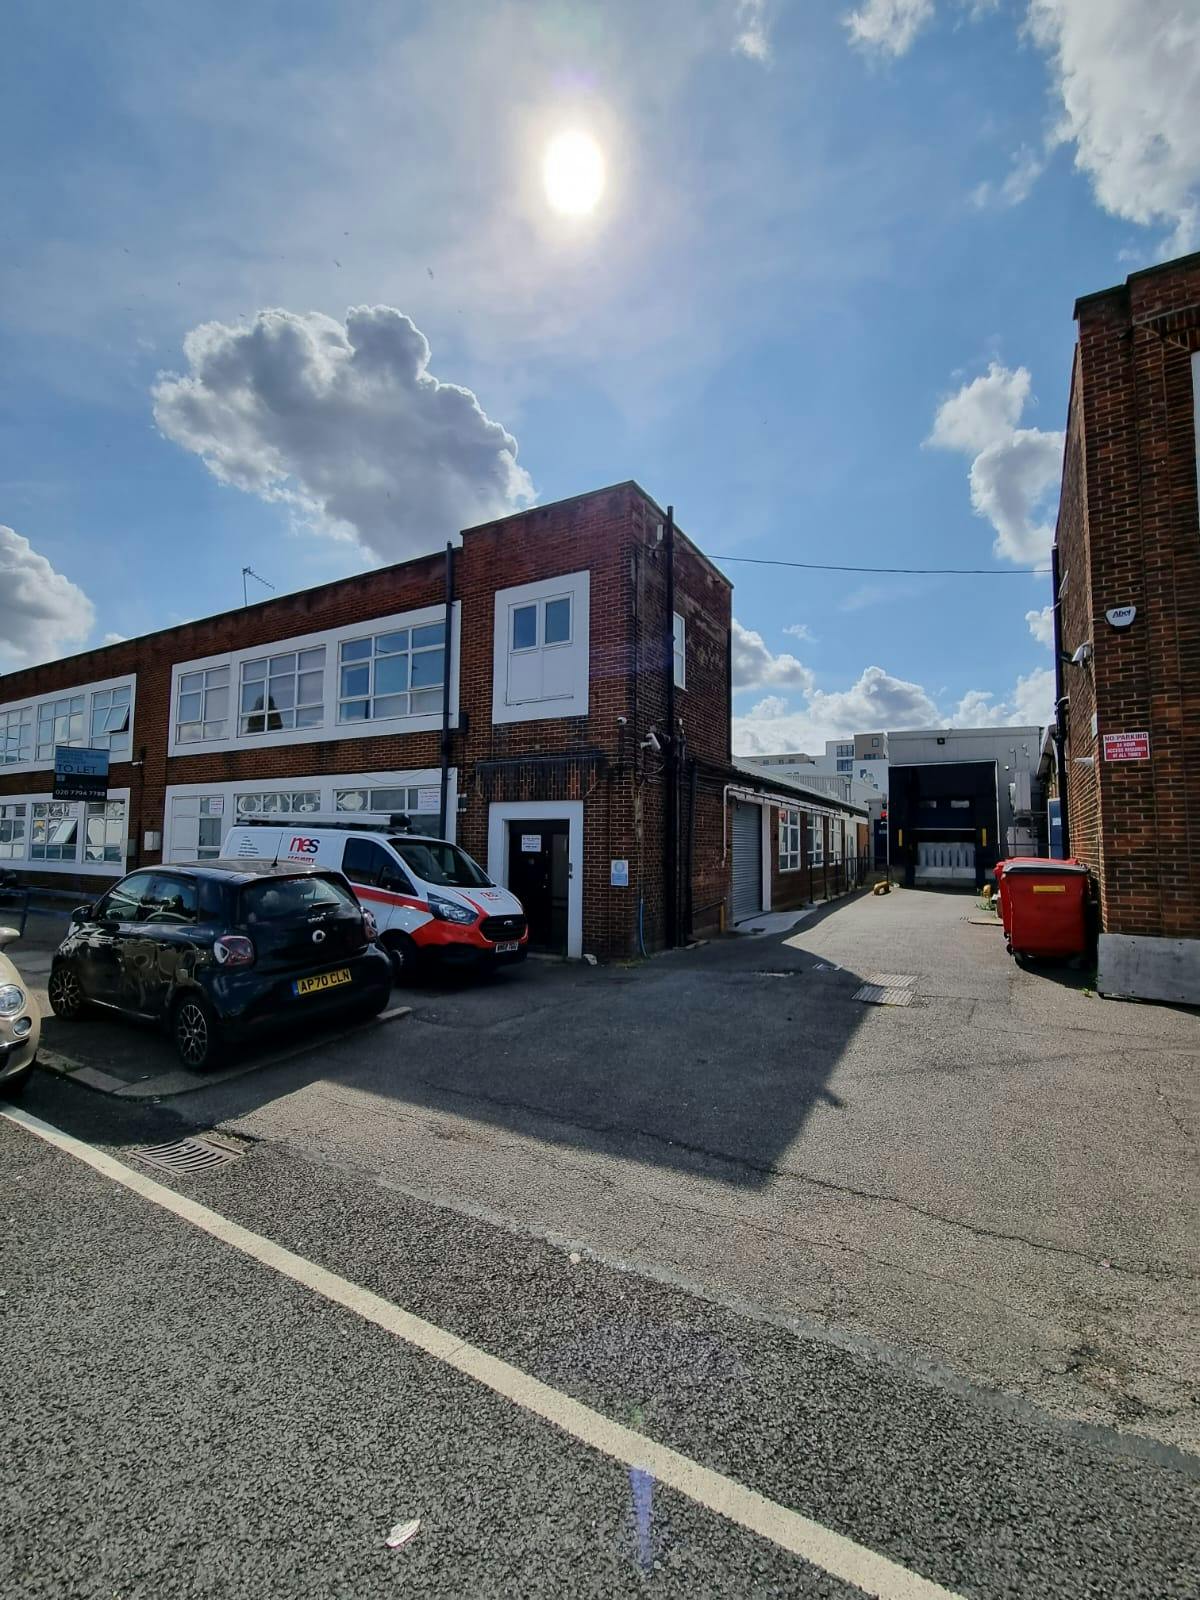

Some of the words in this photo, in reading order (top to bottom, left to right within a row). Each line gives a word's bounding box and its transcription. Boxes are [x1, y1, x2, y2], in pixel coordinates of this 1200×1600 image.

[1116, 732, 1148, 741] PARKING
[56, 764, 73, 773] TO
[77, 765, 96, 774] LET
[289, 837, 320, 853] nes
[301, 975, 328, 992] AP70
[330, 970, 349, 984] CLN
